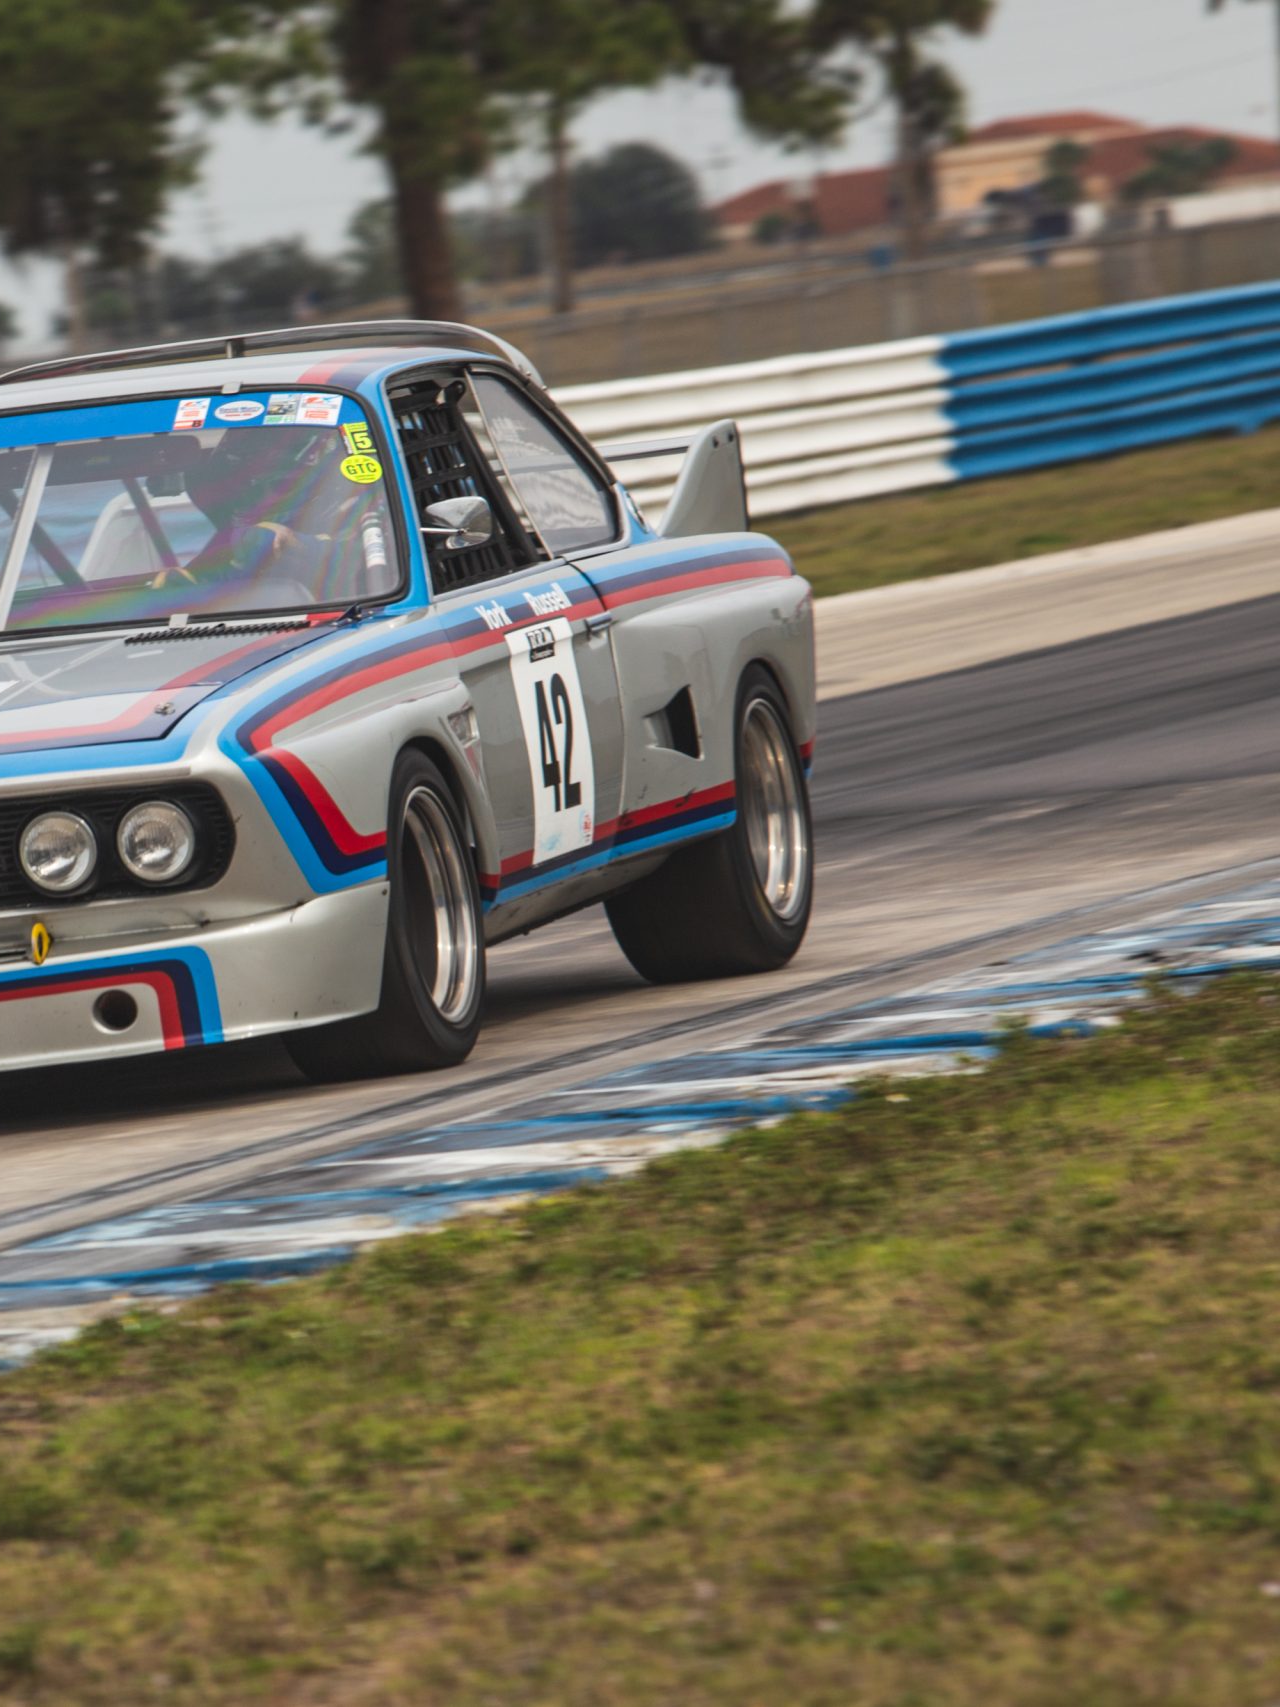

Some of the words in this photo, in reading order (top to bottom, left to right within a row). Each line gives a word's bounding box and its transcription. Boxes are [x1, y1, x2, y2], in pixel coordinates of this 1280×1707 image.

[353, 432, 373, 449] 5
[346, 462, 376, 475] GTC
[474, 600, 513, 630] York
[522, 582, 572, 616] Russell
[534, 672, 582, 812] 42
